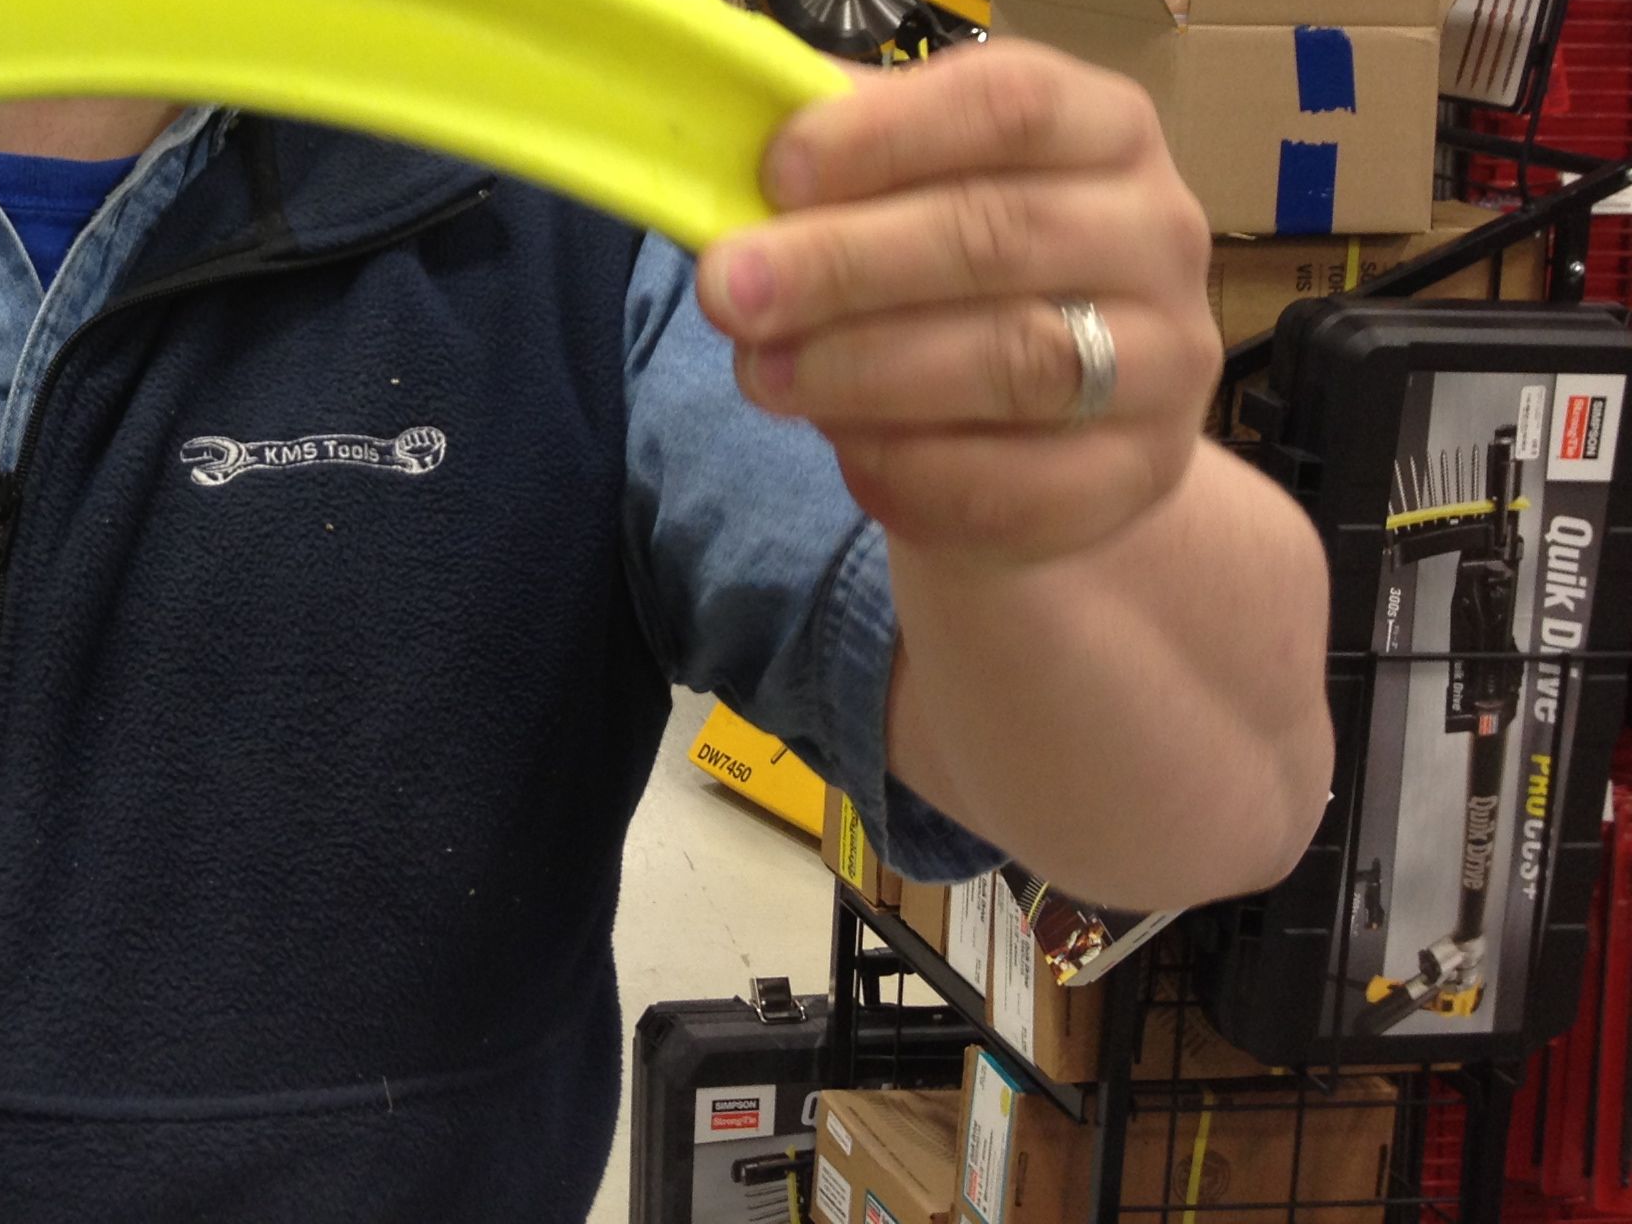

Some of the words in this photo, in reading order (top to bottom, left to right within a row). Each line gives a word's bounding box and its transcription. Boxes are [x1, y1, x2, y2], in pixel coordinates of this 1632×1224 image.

[264, 440, 317, 464] KMS
[323, 439, 380, 462] Tools
[1585, 400, 1605, 456] SIMPSON
[1542, 514, 1593, 613] Quik
[1533, 618, 1584, 724] Dive
[697, 742, 753, 784] DW7450
[1466, 794, 1500, 842] Quik
[1462, 844, 1495, 892] Drive
[714, 1100, 757, 1111] SIMPSON
